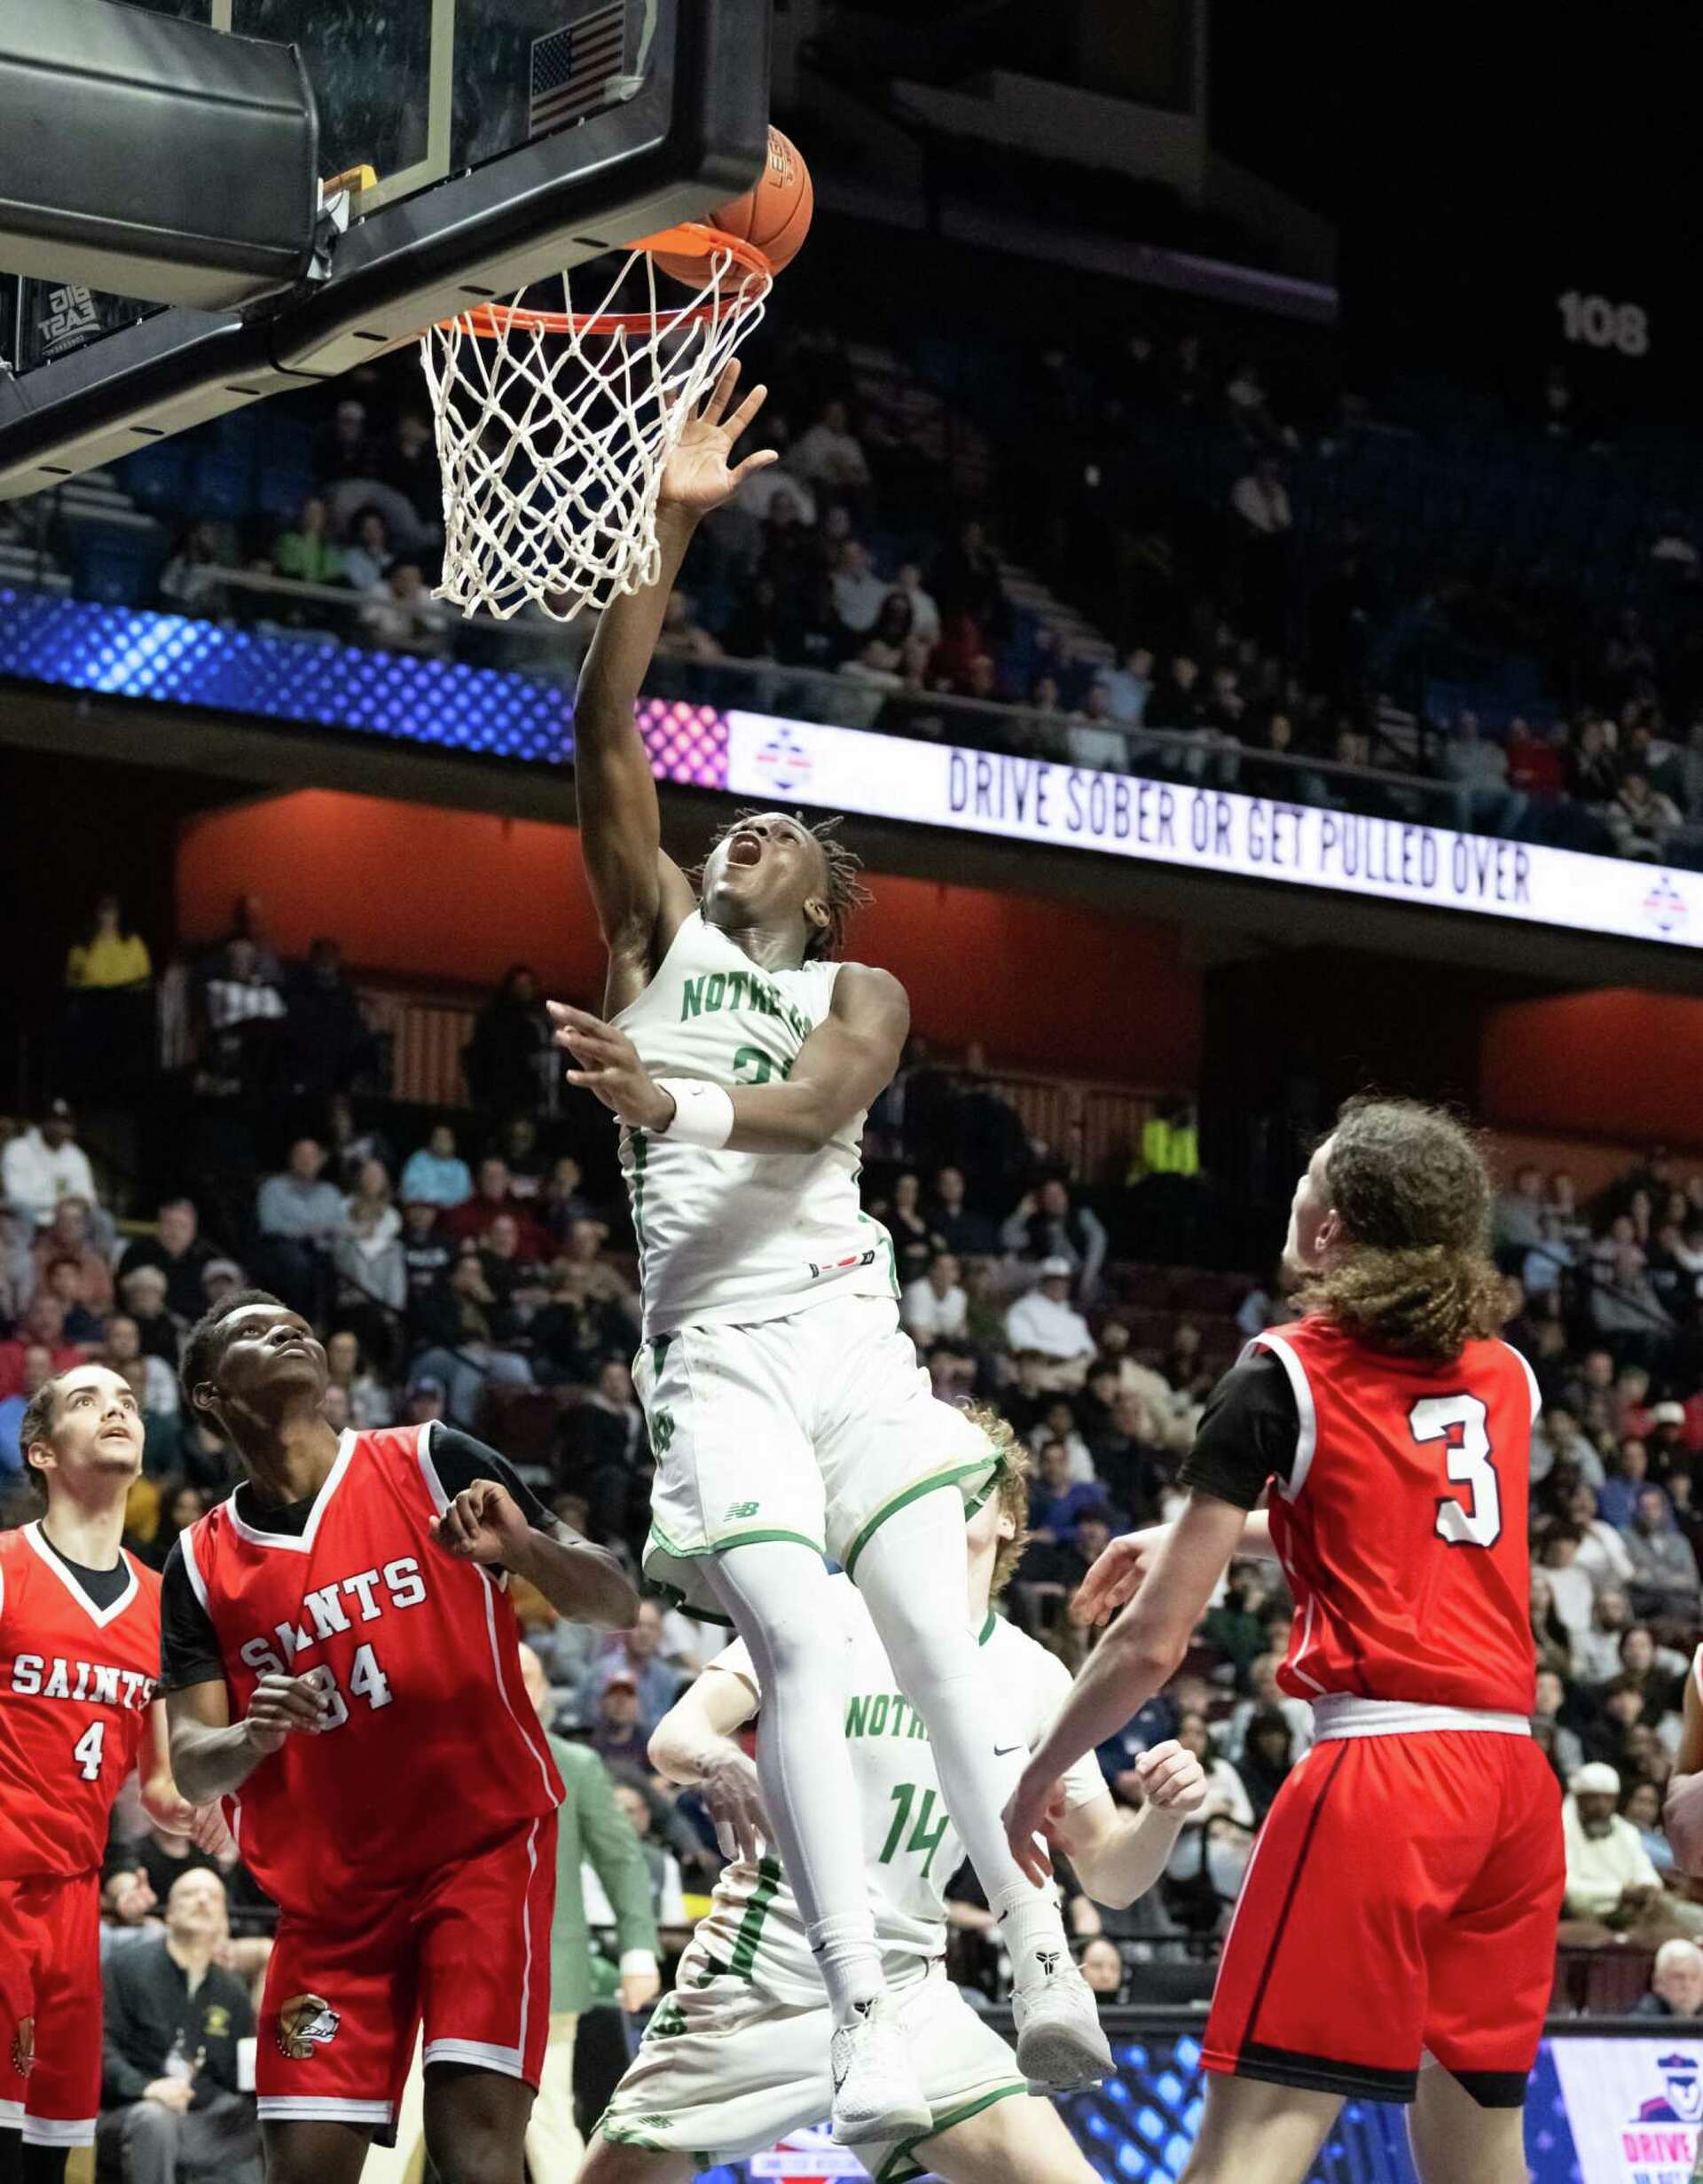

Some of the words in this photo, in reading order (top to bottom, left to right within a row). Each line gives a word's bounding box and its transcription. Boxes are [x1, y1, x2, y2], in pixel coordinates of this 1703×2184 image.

[1559, 291, 1648, 356] 108
[950, 752, 1050, 827] DRIVE
[1067, 770, 1174, 847] SOBER
[1192, 791, 1231, 856] OR
[1248, 802, 1305, 866] GET
[1321, 814, 1437, 887] PULLED
[1453, 835, 1529, 902] OVER
[1409, 1394, 1501, 1547] 3
[12, 1654, 158, 1711] SAINTS
[845, 1694, 930, 1741] NOTR
[75, 1721, 105, 1779] 4
[878, 1782, 950, 1879] 14
[1622, 2133, 1692, 2162] DRIVE
